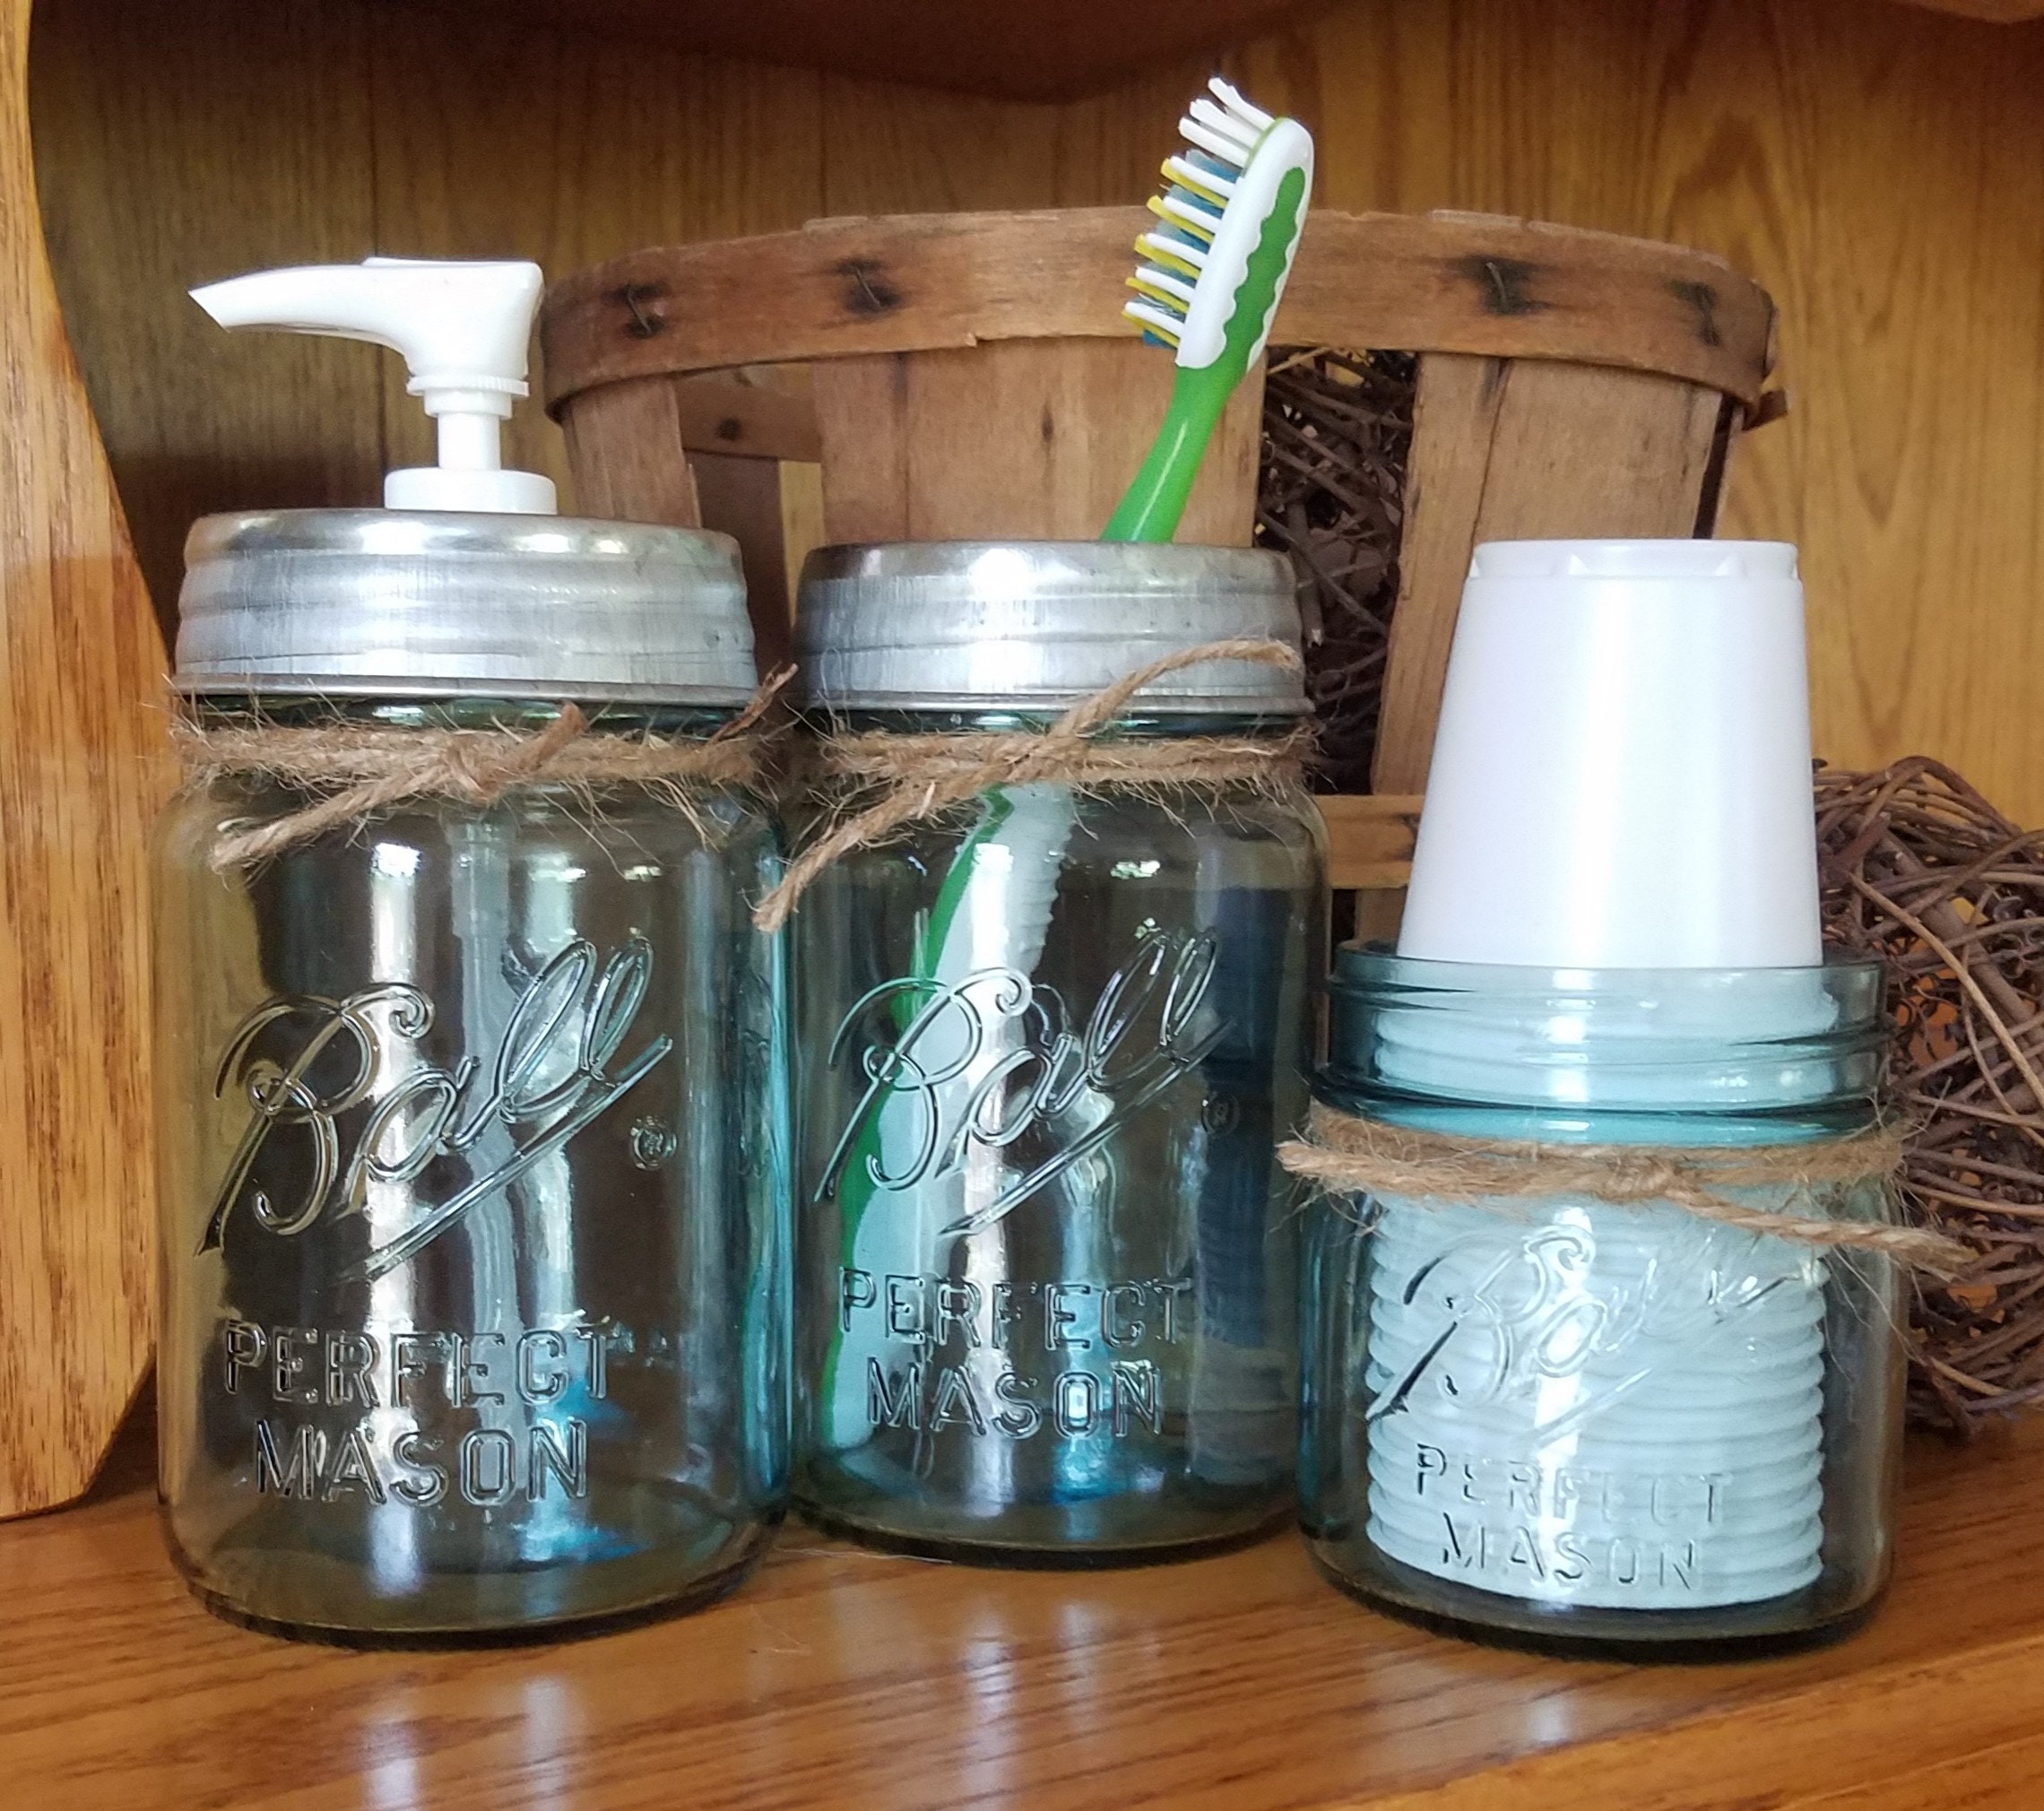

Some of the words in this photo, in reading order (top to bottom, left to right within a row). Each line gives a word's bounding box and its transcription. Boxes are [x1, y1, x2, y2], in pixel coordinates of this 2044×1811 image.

[194, 931, 673, 1282] Ball
[814, 927, 1235, 1236] Ball
[837, 1266, 1194, 1351] PERFECT
[219, 1318, 619, 1409] PERFECT
[866, 1356, 1164, 1439] MASON
[255, 1417, 589, 1506] MASON
[1416, 1443, 1735, 1528] PERFECT
[1441, 1511, 1703, 1592] MASON
